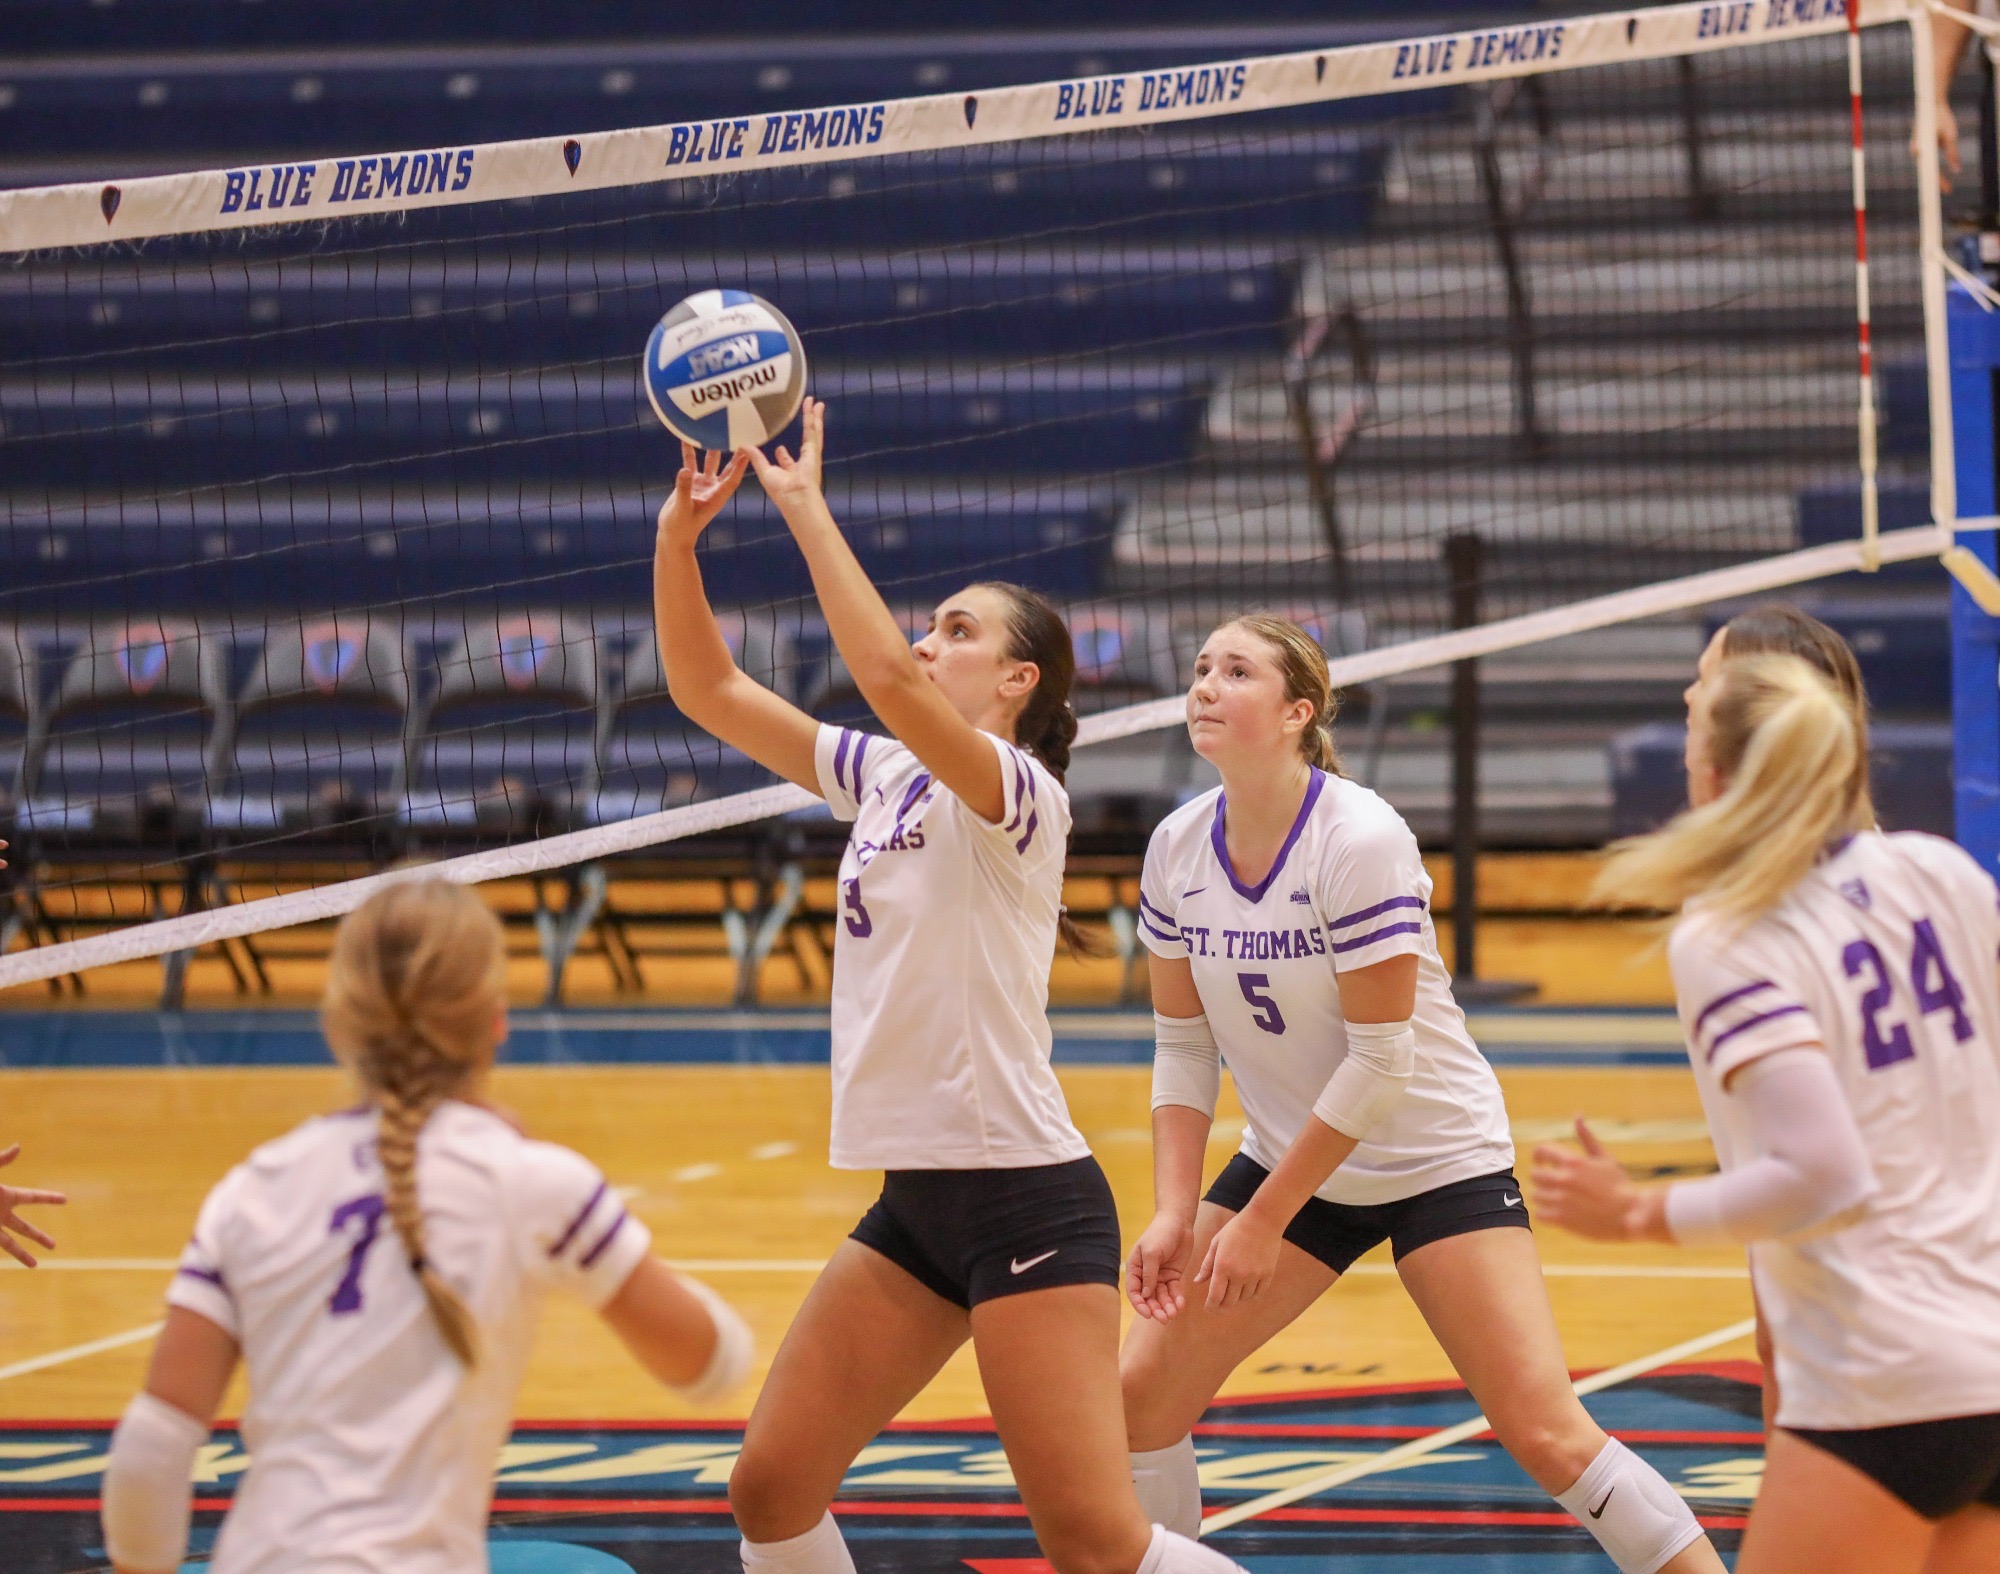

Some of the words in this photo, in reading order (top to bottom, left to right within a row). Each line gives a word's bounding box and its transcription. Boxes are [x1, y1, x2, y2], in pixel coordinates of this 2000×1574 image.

[1393, 39, 1457, 79] BLUE
[1466, 26, 1565, 69] DEMONS
[1054, 79, 1126, 121] BLUE
[1137, 65, 1248, 112] DEMONS
[666, 119, 750, 166] BLUE
[757, 105, 886, 156] DEMONS
[219, 165, 317, 214] BLUE
[328, 149, 475, 202] DEMONS
[687, 333, 760, 378] NCAA
[691, 364, 777, 405] molten
[842, 876, 873, 938] 3
[1180, 926, 1216, 958] ST.
[1223, 927, 1326, 960] THOMAS
[1236, 972, 1287, 1036] 5
[1842, 917, 1975, 1072] 24
[329, 1193, 386, 1315] 7
